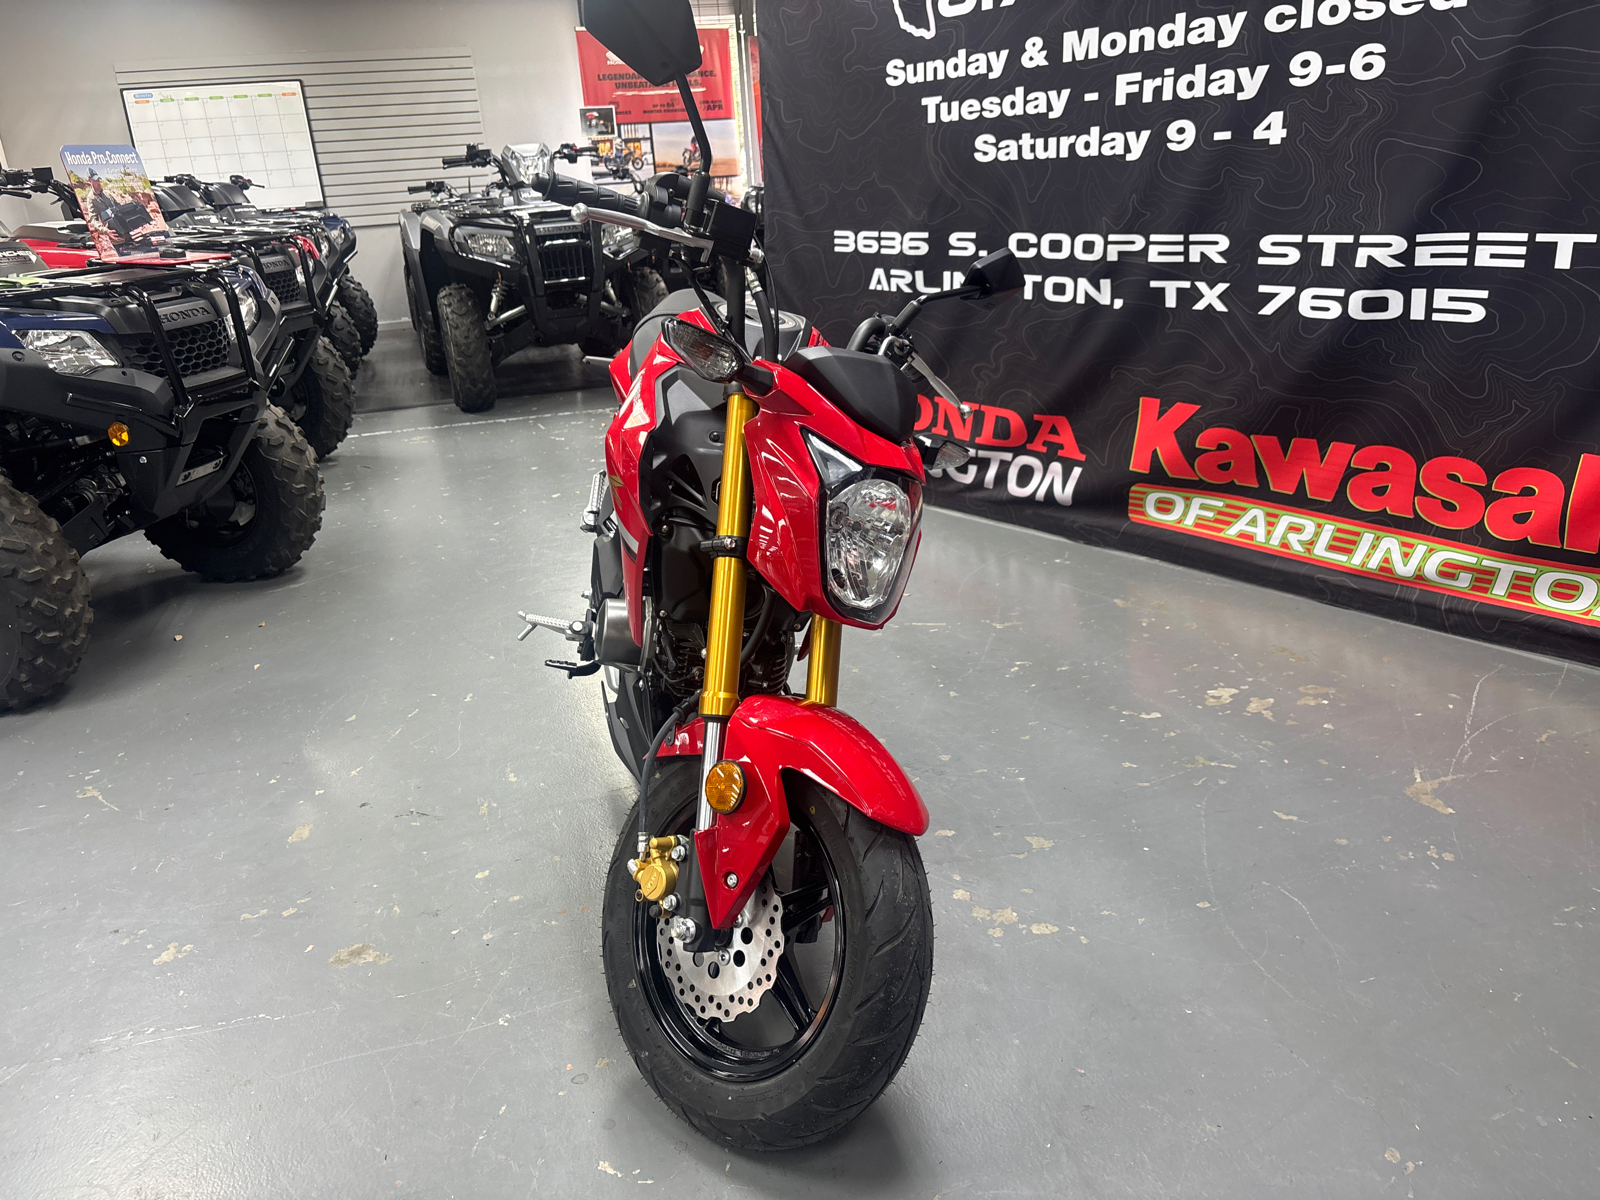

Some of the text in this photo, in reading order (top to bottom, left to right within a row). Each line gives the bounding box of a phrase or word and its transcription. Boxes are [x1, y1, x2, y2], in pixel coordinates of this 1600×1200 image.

[886, 0, 1468, 87] Sunday & Monday close
[921, 42, 1387, 124] Tuesday - Friday 9-6
[64, 150, 139, 165] Honda Pro-Connect
[973, 110, 1288, 163] Saturday 9 - 4
[833, 229, 1598, 270] 3636 S. COOPER STREET
[159, 306, 211, 324] HONDA
[868, 267, 1490, 323] ARLITON, TX 76015
[1144, 491, 1600, 617] OF ARLINGTO
